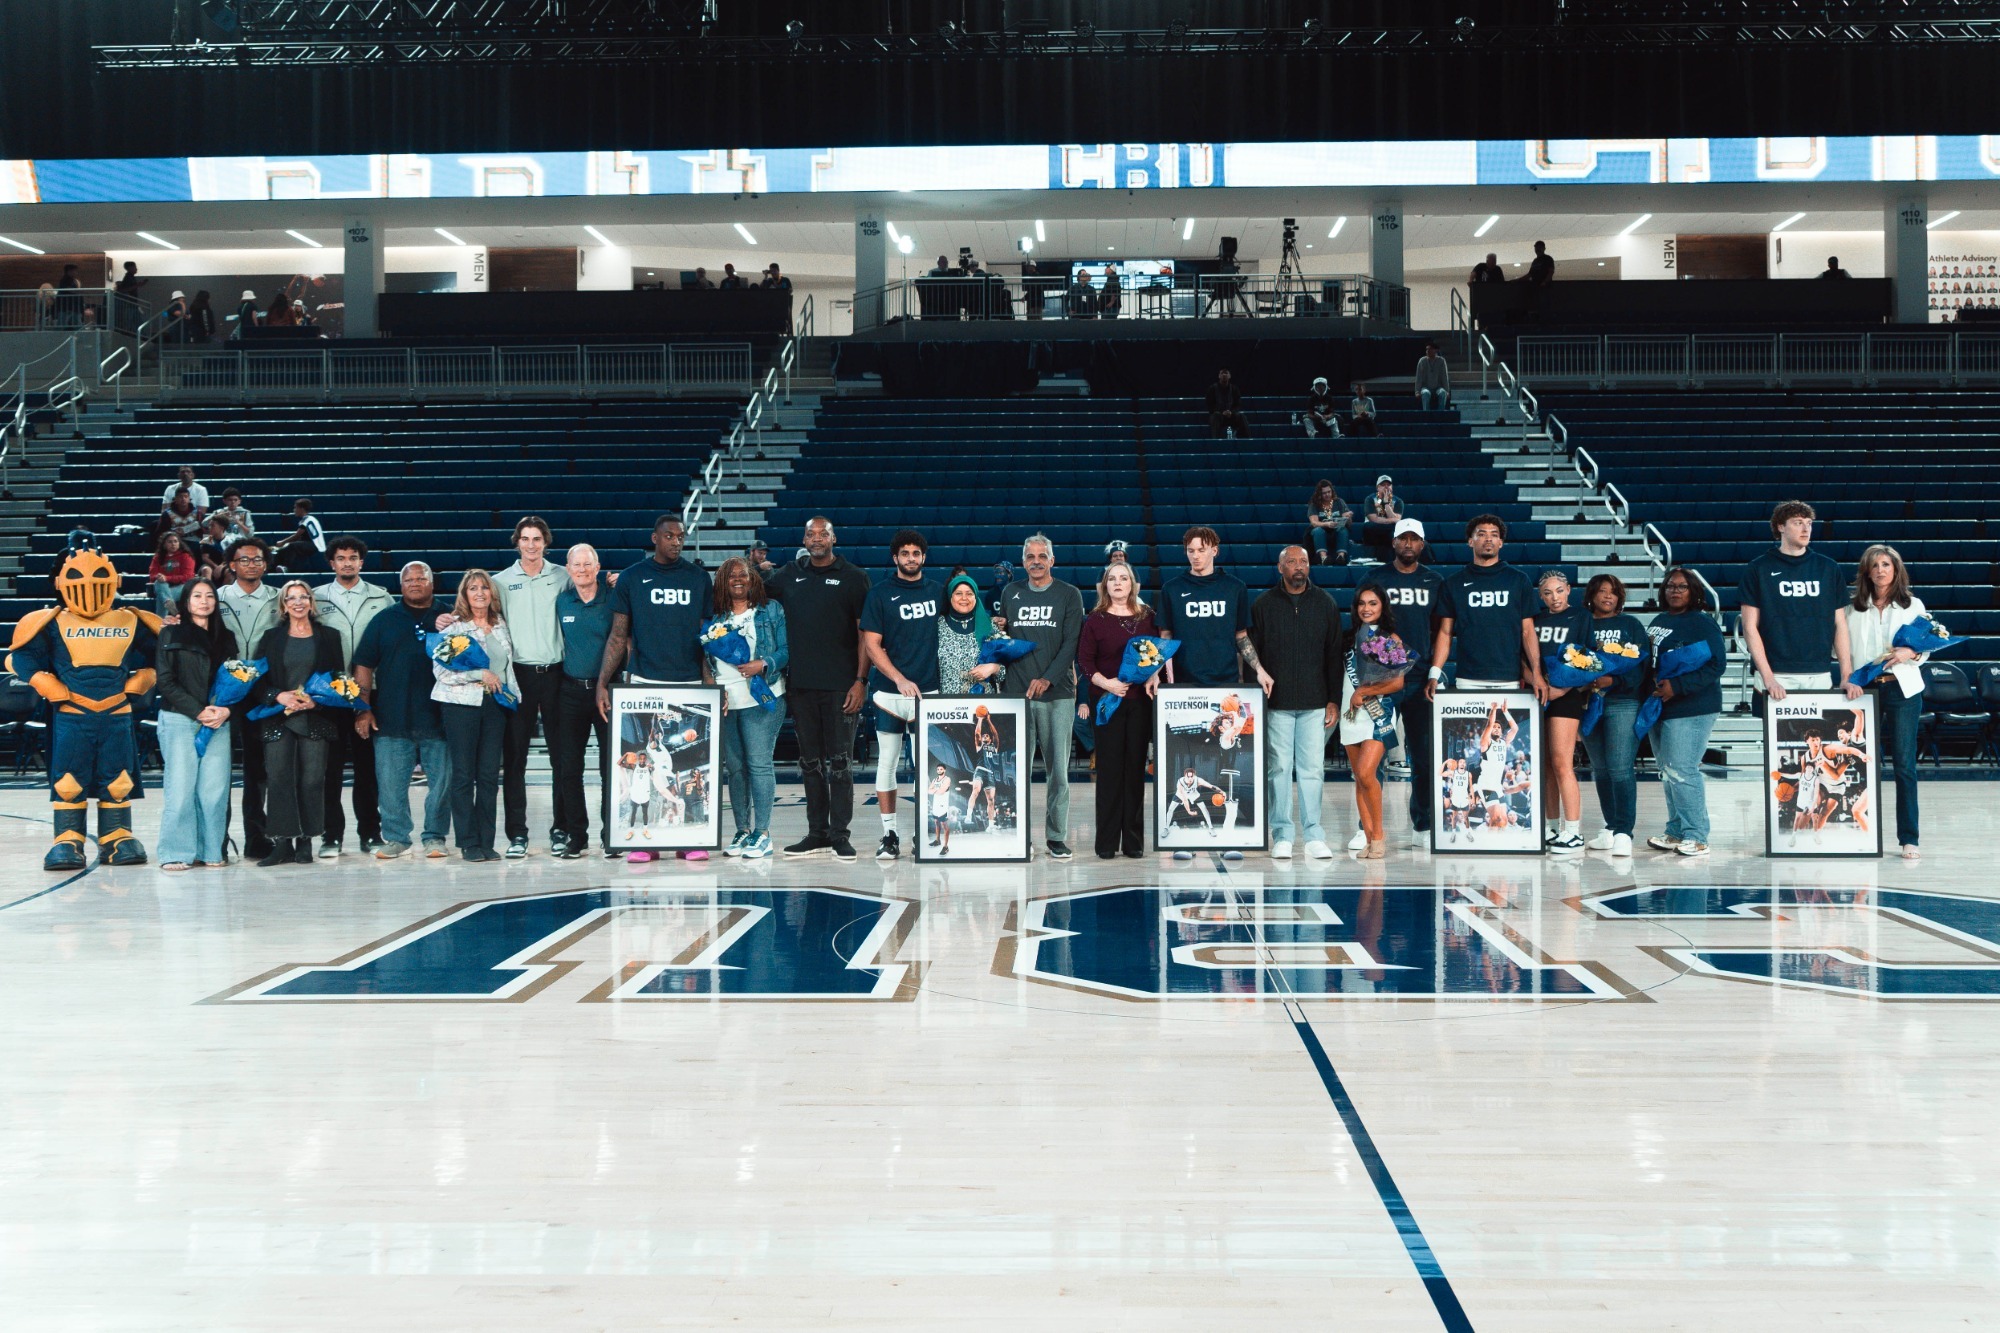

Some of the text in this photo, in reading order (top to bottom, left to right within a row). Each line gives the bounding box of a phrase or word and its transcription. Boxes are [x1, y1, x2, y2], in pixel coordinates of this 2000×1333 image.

[1049, 143, 1225, 189] CBU
[1664, 240, 1675, 269] MEN
[1929, 254, 1998, 263] Athlete Advisory
[474, 253, 485, 282] MEN
[508, 583, 523, 591] CBU
[1779, 581, 1820, 597] CBU
[650, 588, 691, 605] CBU
[1468, 591, 1509, 607] CBU
[900, 600, 937, 620] CBU
[1018, 606, 1053, 620] CBU
[1185, 600, 1226, 617] CBU
[1013, 620, 1057, 628] BASKETBALL
[66, 627, 130, 638] LANCERS
[620, 701, 664, 710] COLEMAN
[1164, 701, 1209, 710] STEVENSON
[1441, 706, 1486, 715] JOHNSON
[926, 711, 969, 720] MOUSSA
[1775, 707, 1818, 716] BRAUN
[1497, 754, 1505, 762] 13
